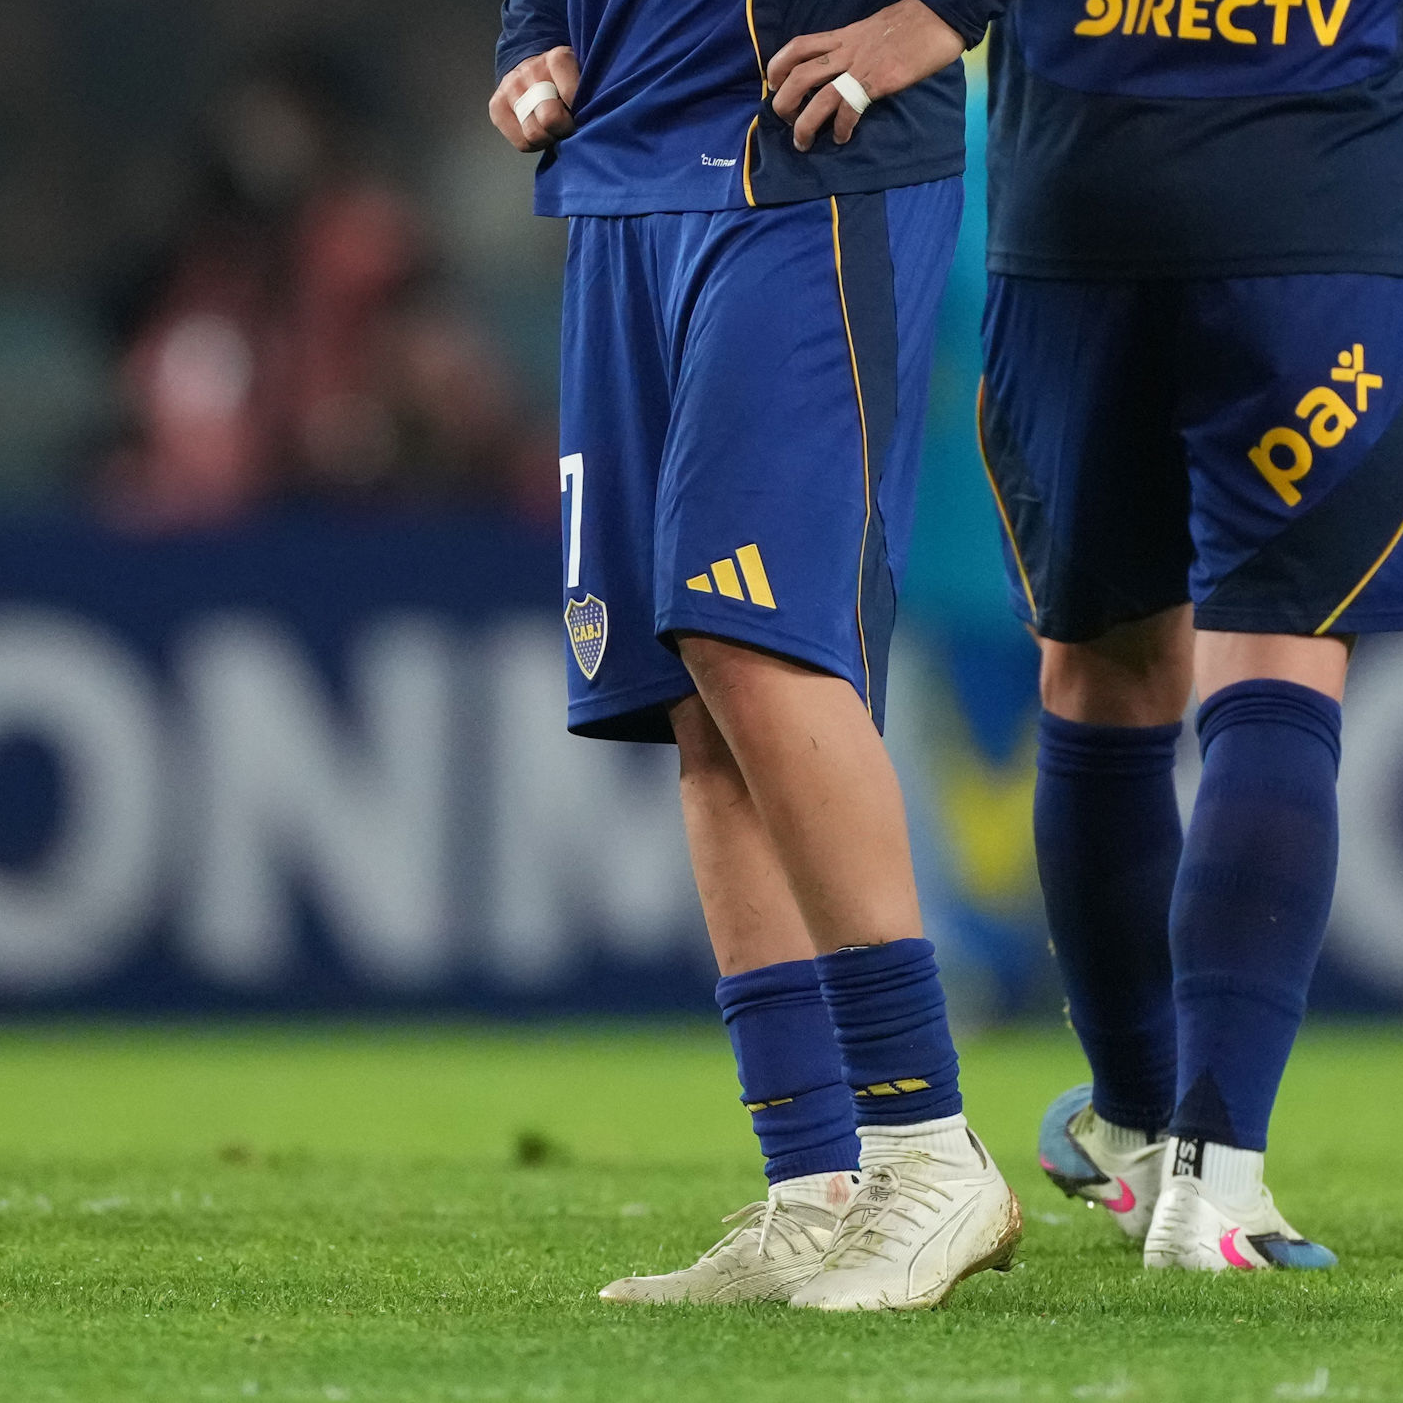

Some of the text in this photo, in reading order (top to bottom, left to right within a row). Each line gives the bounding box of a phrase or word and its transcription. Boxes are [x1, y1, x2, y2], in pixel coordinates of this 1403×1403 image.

[1248, 343, 1383, 507] pax
[559, 452, 584, 588] 7
[574, 623, 602, 642] CABJ
